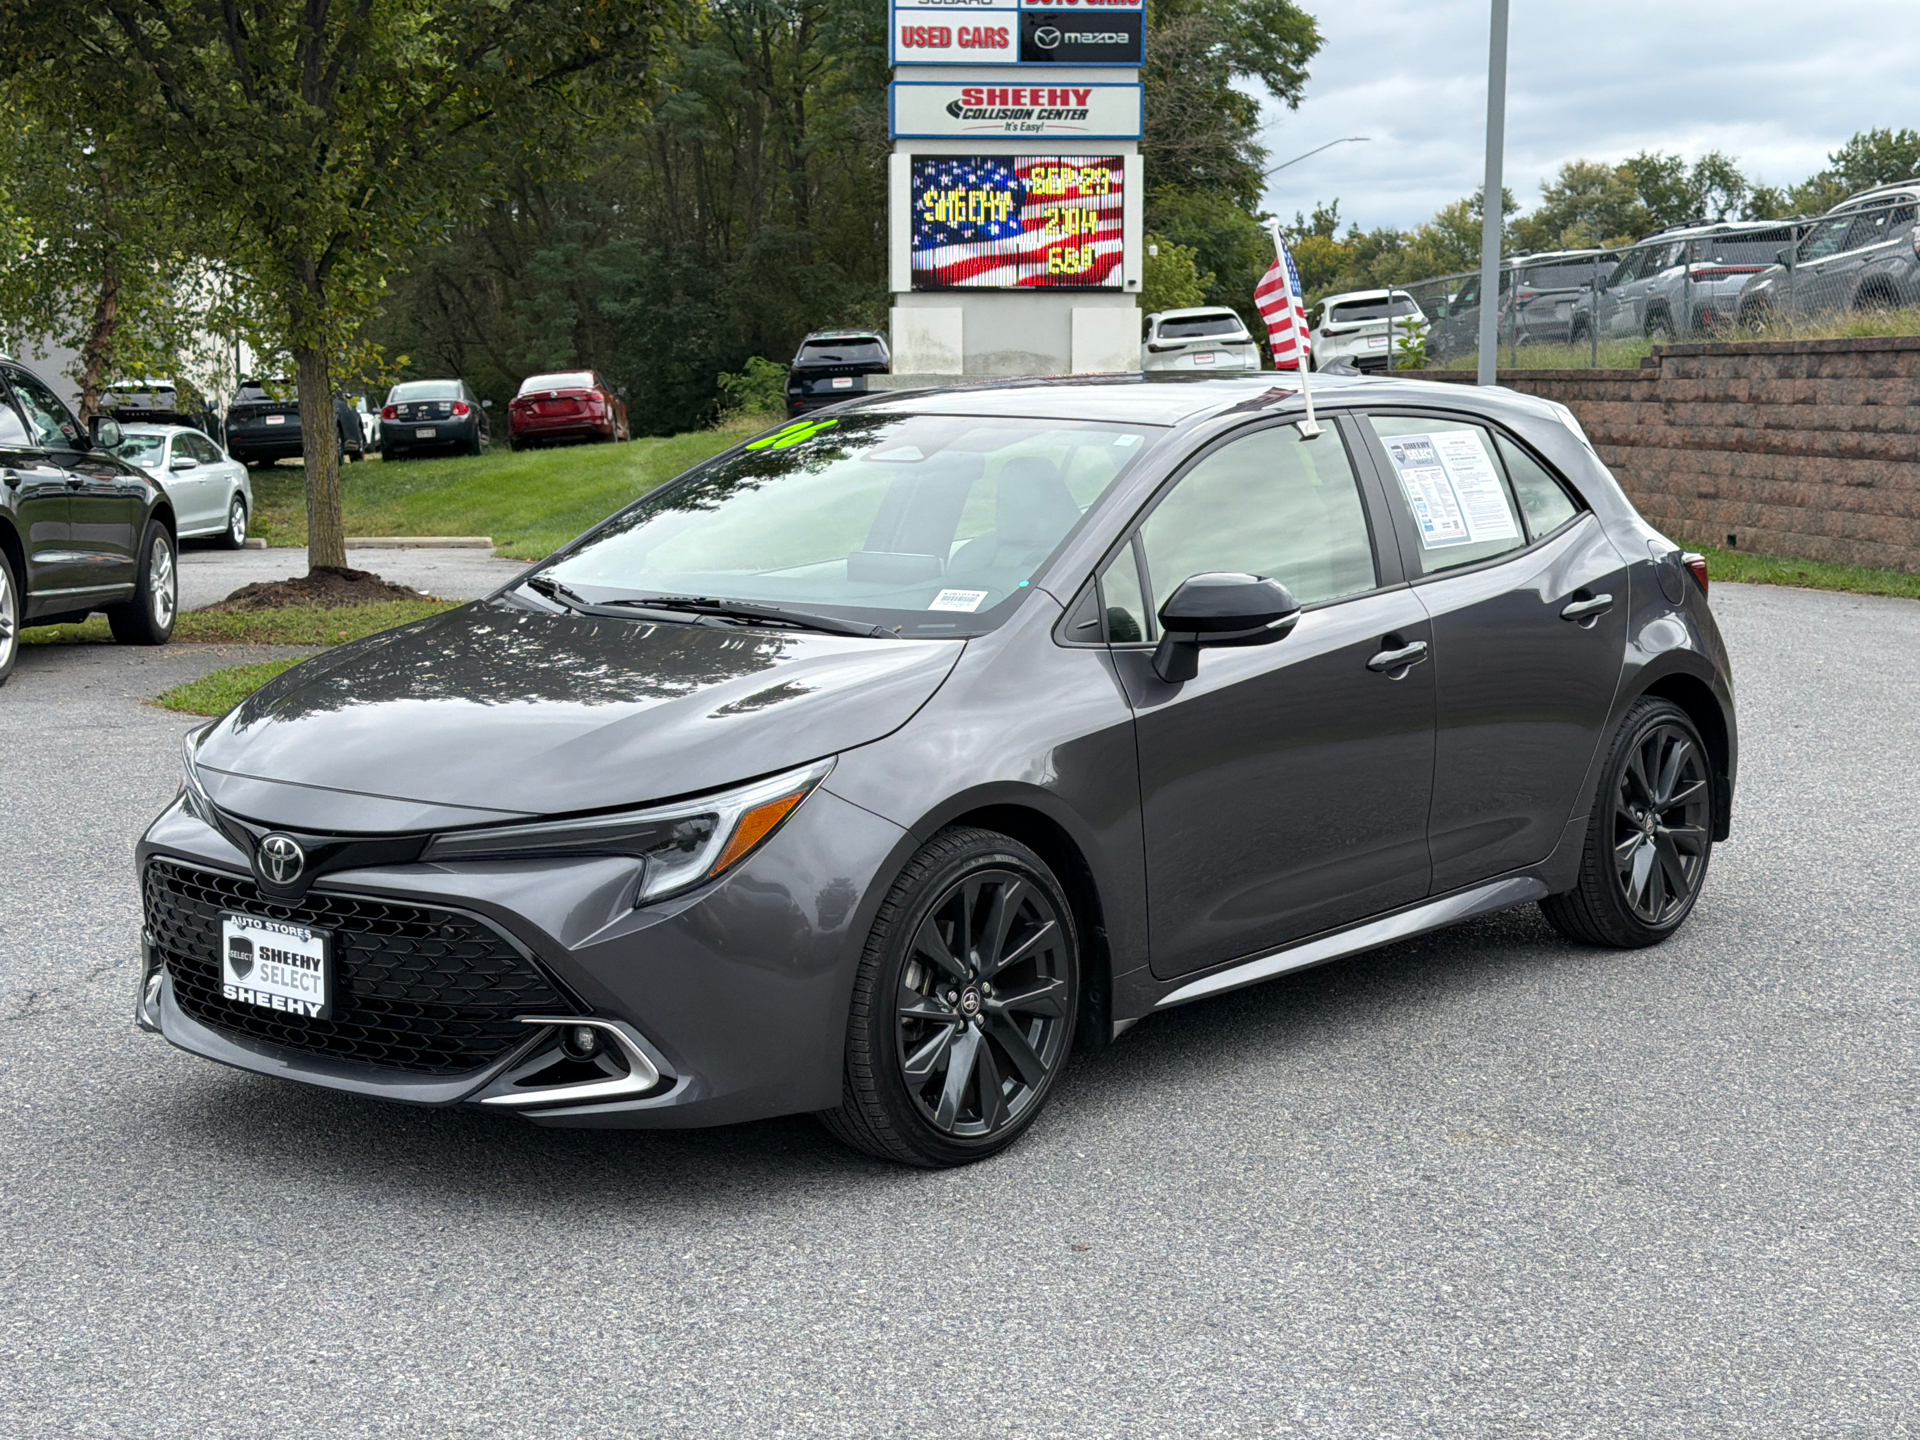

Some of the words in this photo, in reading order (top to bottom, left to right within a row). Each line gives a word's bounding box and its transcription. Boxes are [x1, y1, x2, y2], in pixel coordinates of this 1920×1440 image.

[901, 26, 952, 48] USED
[957, 26, 1009, 48] CARS
[961, 88, 1092, 106] SHEEHY
[962, 108, 1034, 120] COLLISION
[1036, 108, 1089, 120] CENTER
[1004, 122, 1018, 131] It's
[1020, 122, 1044, 133] Easy!
[1031, 167, 1075, 195] SEP
[1406, 448, 1435, 460] SELECT
[230, 915, 262, 929] AUTO
[265, 922, 312, 939] STORES
[230, 950, 253, 961] SELECT
[259, 946, 321, 972] SHEEHY
[260, 963, 321, 993] SELECT
[223, 985, 322, 1018] SHEEHY
